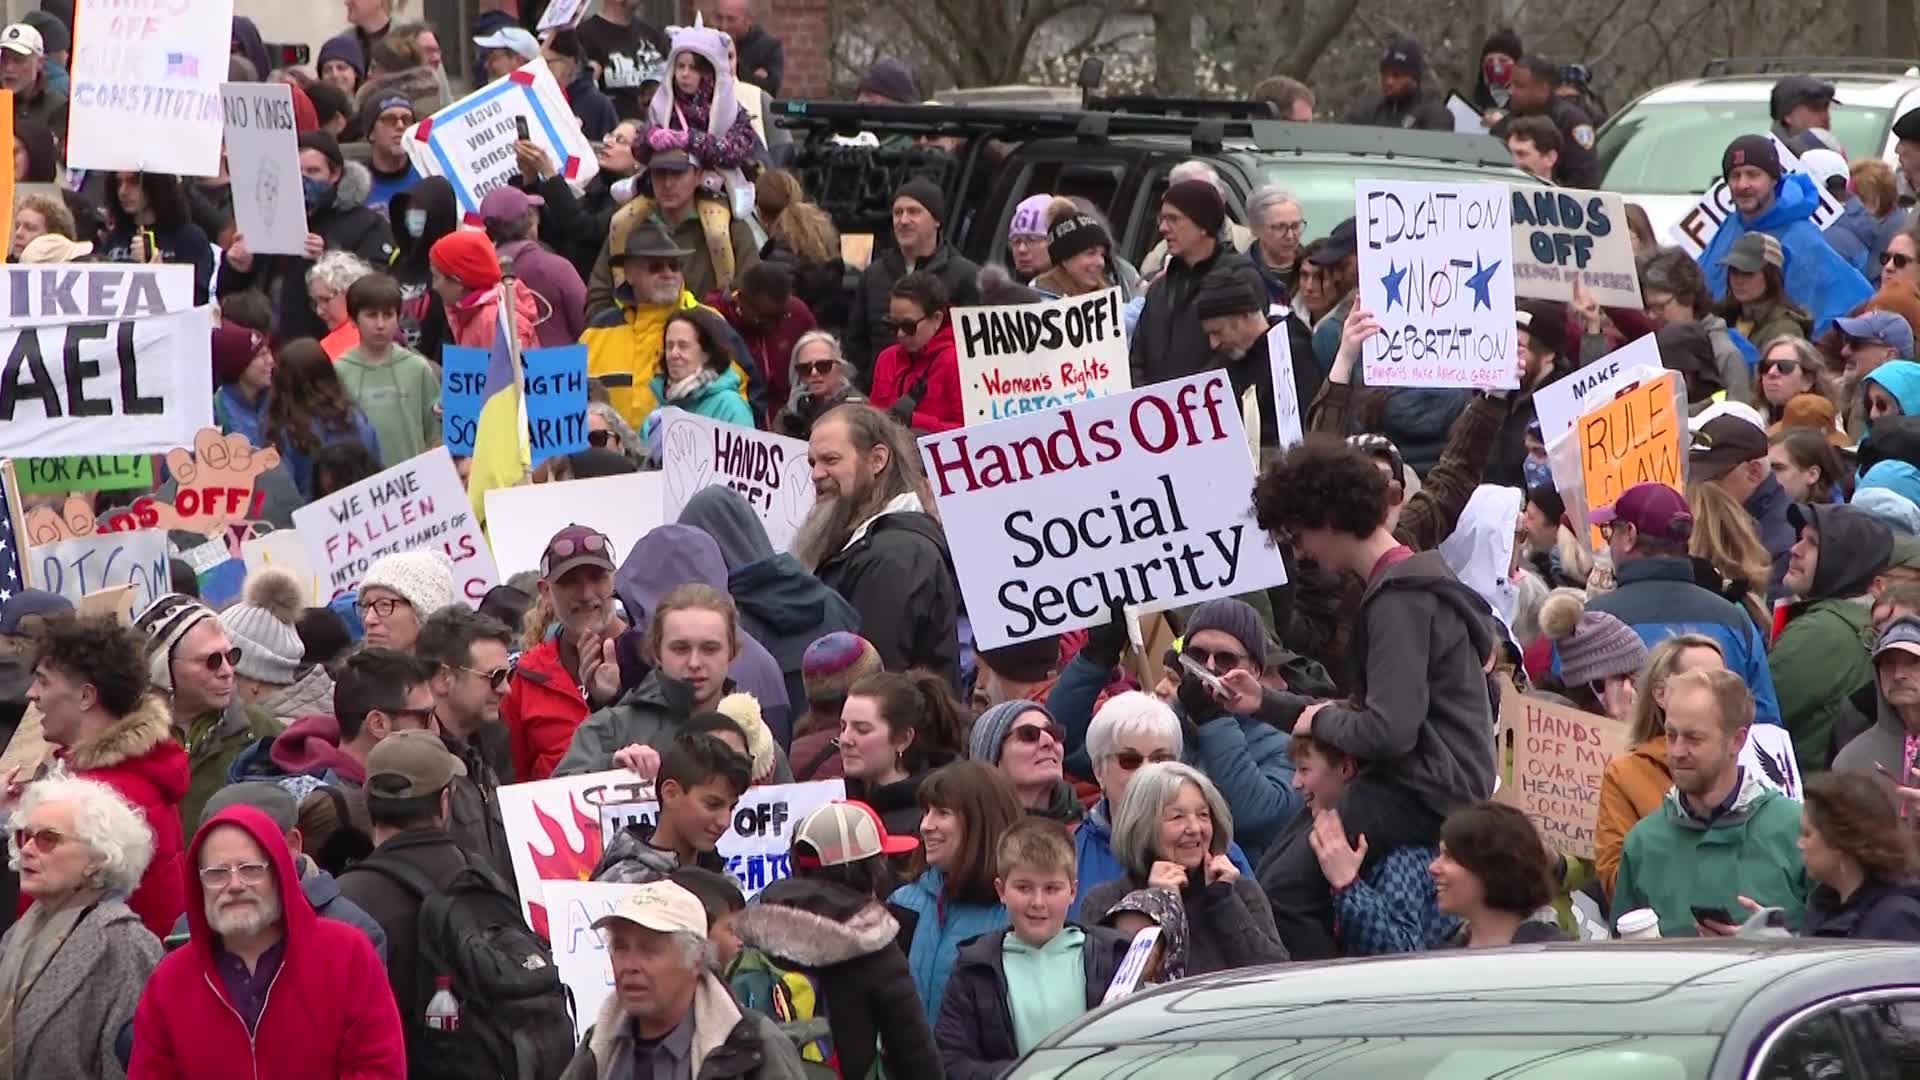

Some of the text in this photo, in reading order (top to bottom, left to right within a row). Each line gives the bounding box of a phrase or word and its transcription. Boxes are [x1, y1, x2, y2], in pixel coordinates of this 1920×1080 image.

[224, 96, 292, 130] NO KINGS
[464, 101, 503, 128] Have
[466, 117, 516, 152] you no
[471, 143, 516, 175] sense
[1368, 191, 1503, 250] EDUCATION
[1511, 190, 1612, 238] ANDS
[1530, 231, 1594, 270] OFF
[8, 270, 167, 317] IKEA
[1406, 258, 1473, 318] NOT
[961, 291, 1121, 358] HANDS OFF!
[1376, 323, 1508, 362] DEPORTATION
[448, 370, 582, 396] STRGTH
[982, 357, 1110, 396] Women's Rights
[448, 410, 587, 449] SORITY
[925, 410, 1122, 497] Hands
[1129, 378, 1229, 455] Off
[1586, 382, 1668, 472] RULE
[30, 454, 145, 484] FOR ALL!
[714, 427, 784, 490] HANDS
[175, 487, 266, 517] OFF!
[329, 471, 420, 524] WE HAVE
[325, 495, 435, 563] FALLEN
[1003, 474, 1189, 569] Social
[330, 559, 369, 587] INTO
[404, 522, 449, 548] HANDS
[450, 511, 469, 529] OF
[998, 525, 1245, 639] Security
[1526, 705, 1601, 746] HANDS
[1527, 737, 1613, 768] OFF MY
[1522, 773, 1599, 806] HEALTHC
[1528, 759, 1601, 791] OVARIE
[734, 801, 789, 838] OFF
[1526, 795, 1592, 822] SOCIAL
